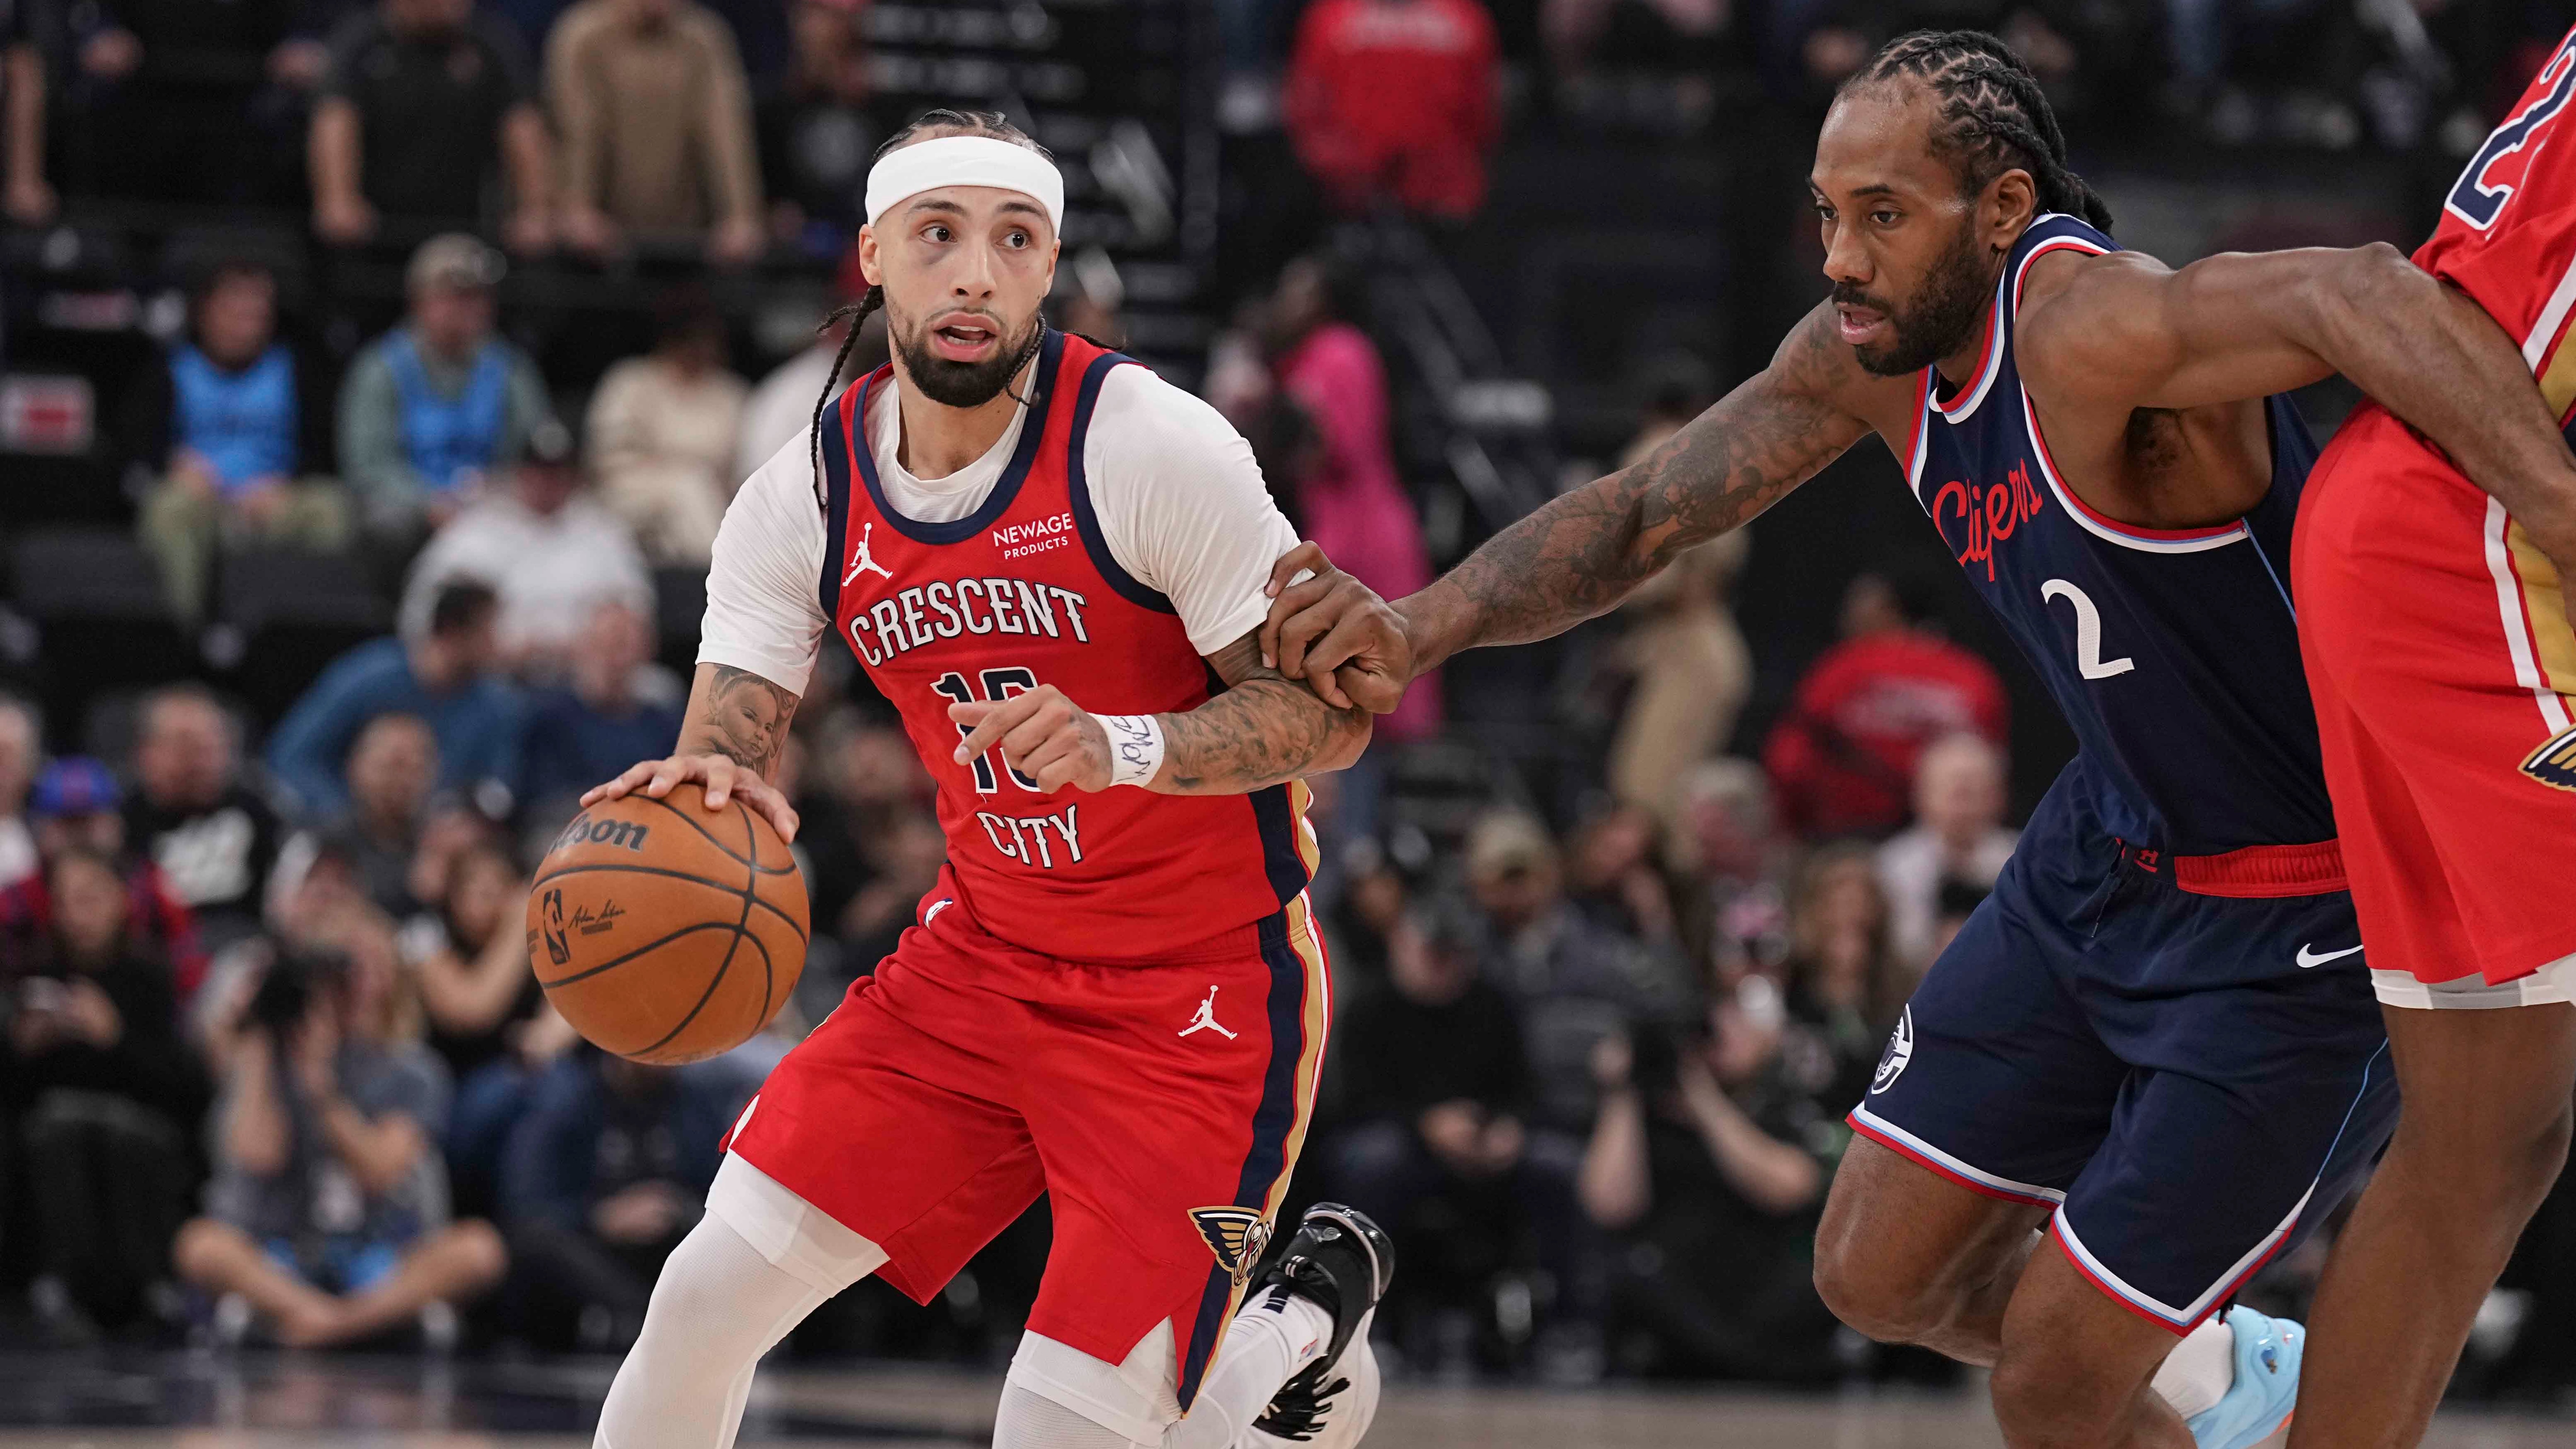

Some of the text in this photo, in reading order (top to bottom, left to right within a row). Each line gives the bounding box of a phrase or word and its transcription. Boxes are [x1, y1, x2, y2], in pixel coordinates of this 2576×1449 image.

[993, 513, 1072, 547] NEWAGE
[1004, 536, 1068, 560] PRODUCTS
[850, 577, 1090, 666] CRESCENT
[2041, 579, 2134, 679] 2
[976, 803, 1083, 869] CITY
